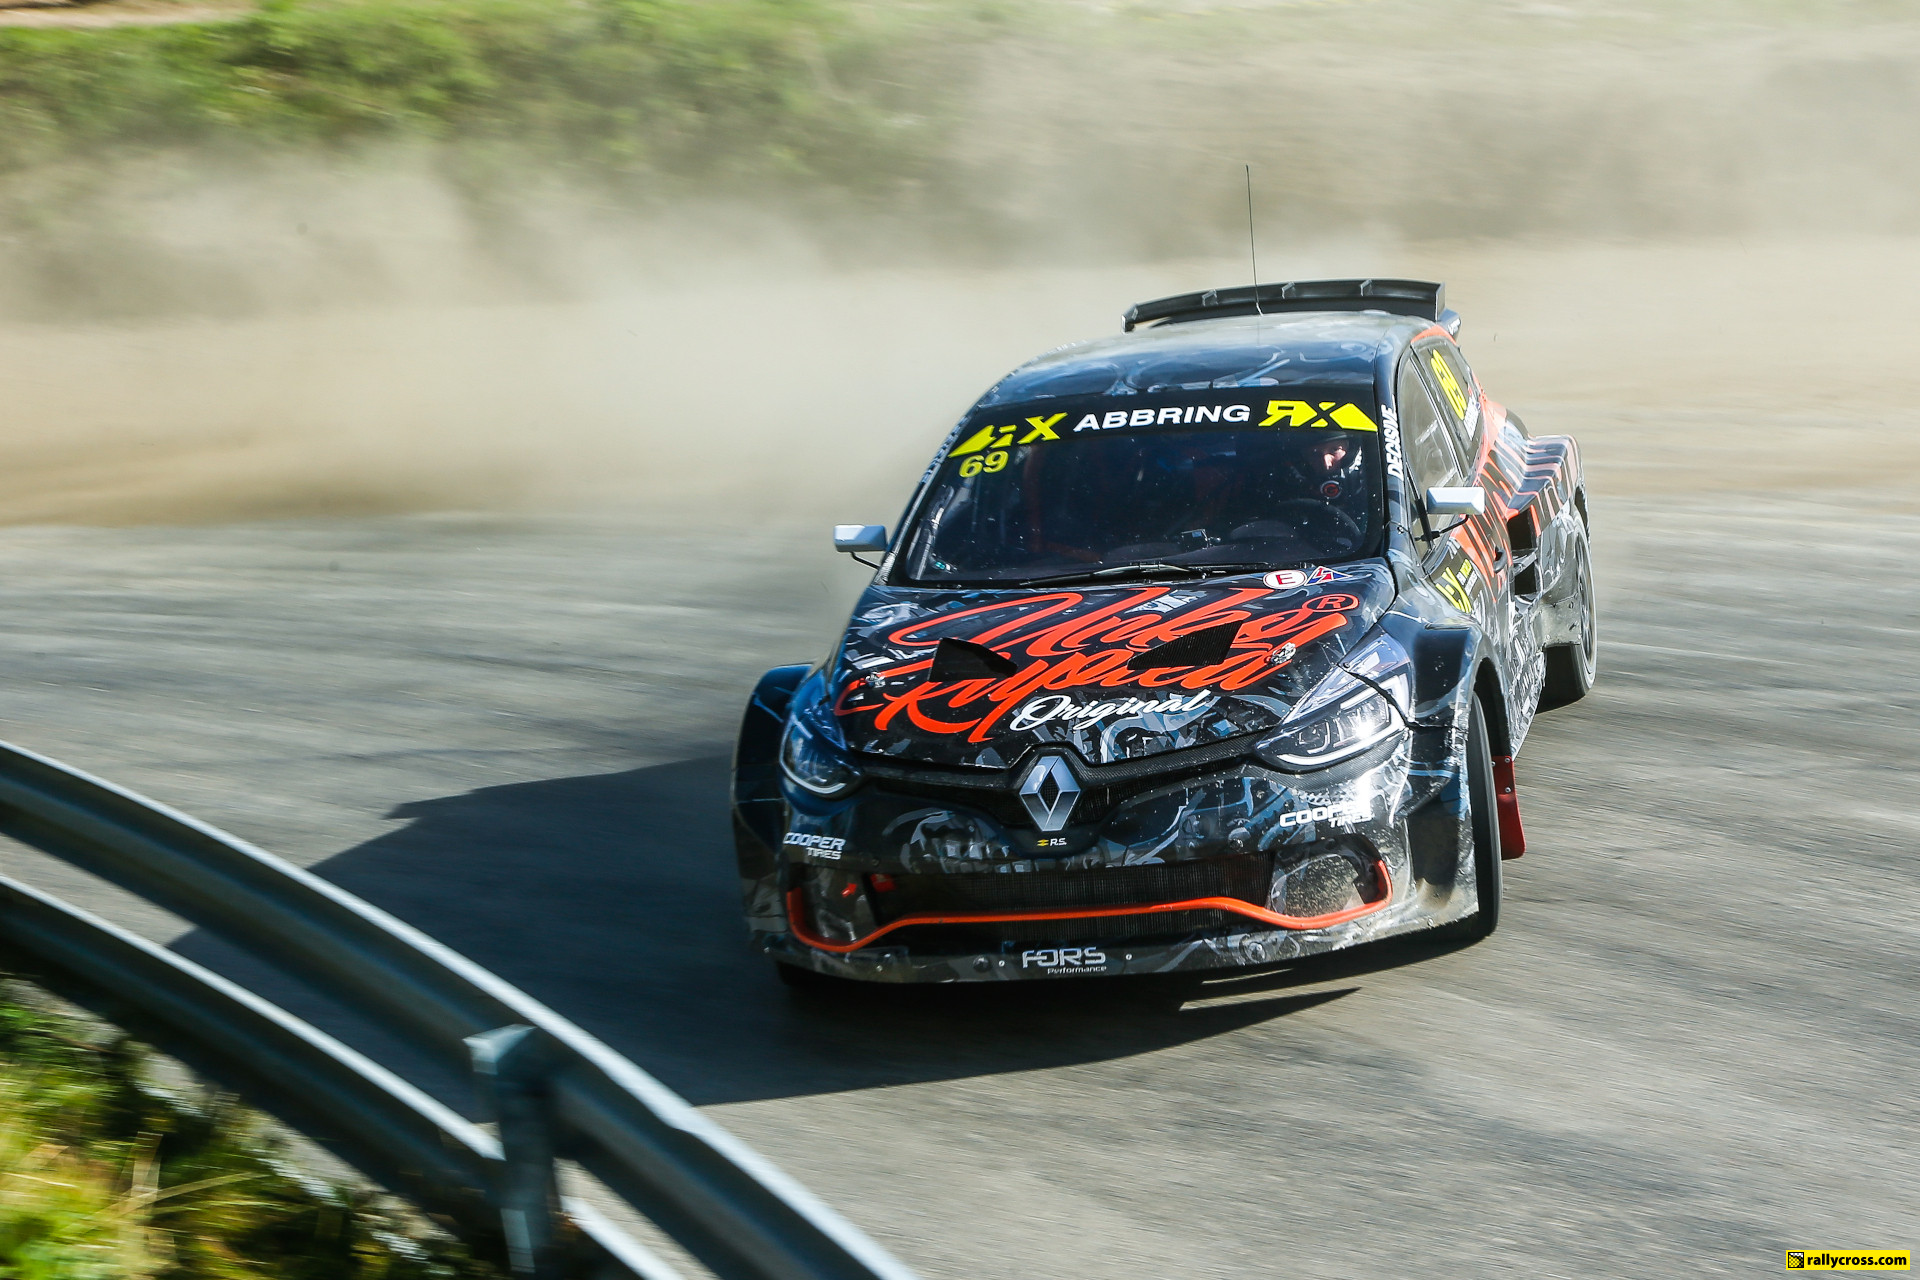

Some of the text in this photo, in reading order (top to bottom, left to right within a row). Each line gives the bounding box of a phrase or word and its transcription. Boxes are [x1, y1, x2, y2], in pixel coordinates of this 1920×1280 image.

[1073, 405, 1250, 432] ABBRING
[1381, 394, 1404, 481] DECISIVE
[959, 451, 1009, 477] 69
[1010, 689, 1211, 731] Original
[783, 832, 846, 850] COOPER
[806, 847, 842, 860] TIRES
[1022, 947, 1106, 968] FORS
[1047, 966, 1107, 974] Performance
